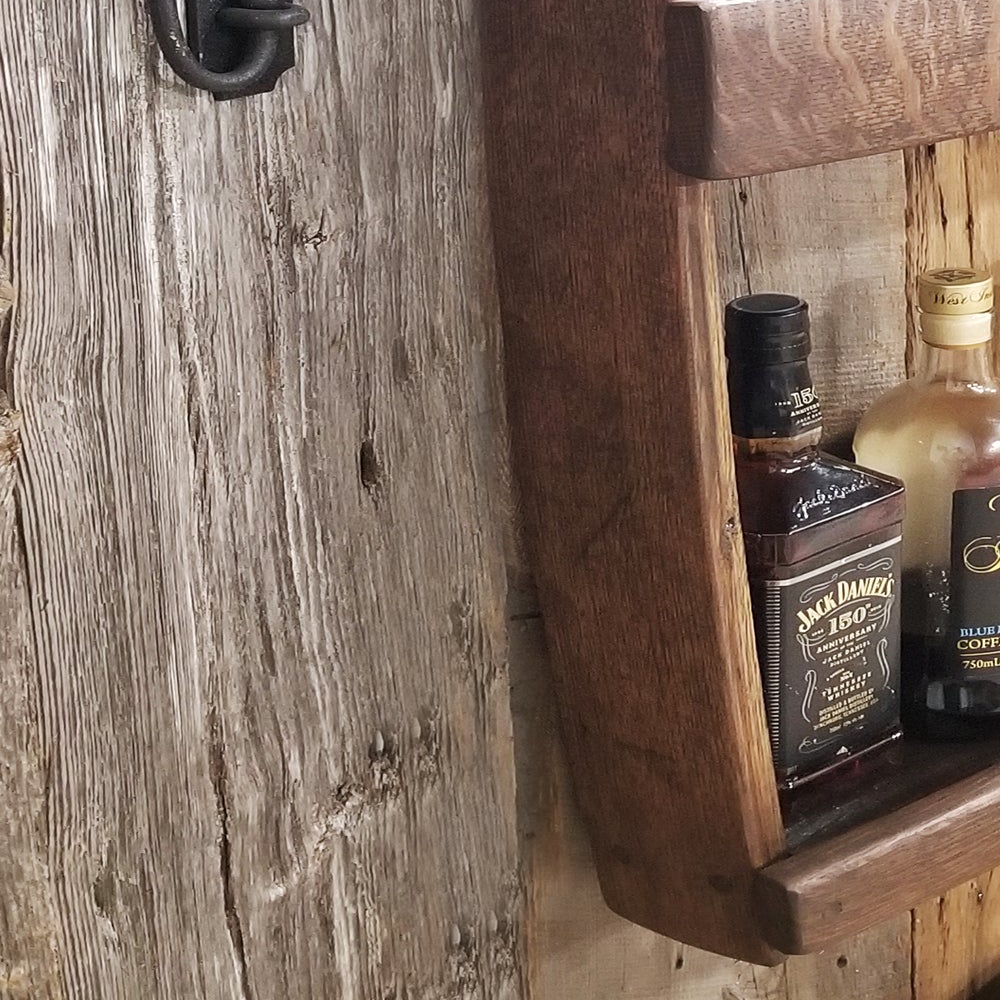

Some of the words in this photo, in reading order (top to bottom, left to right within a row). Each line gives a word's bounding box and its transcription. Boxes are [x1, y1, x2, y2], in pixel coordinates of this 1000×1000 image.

[796, 592, 839, 634] JACK
[837, 572, 895, 601] DANIEL'S
[816, 622, 878, 654] ANNIVERSARY
[960, 623, 996, 638] BLUE
[826, 680, 867, 702] WHISKEY
